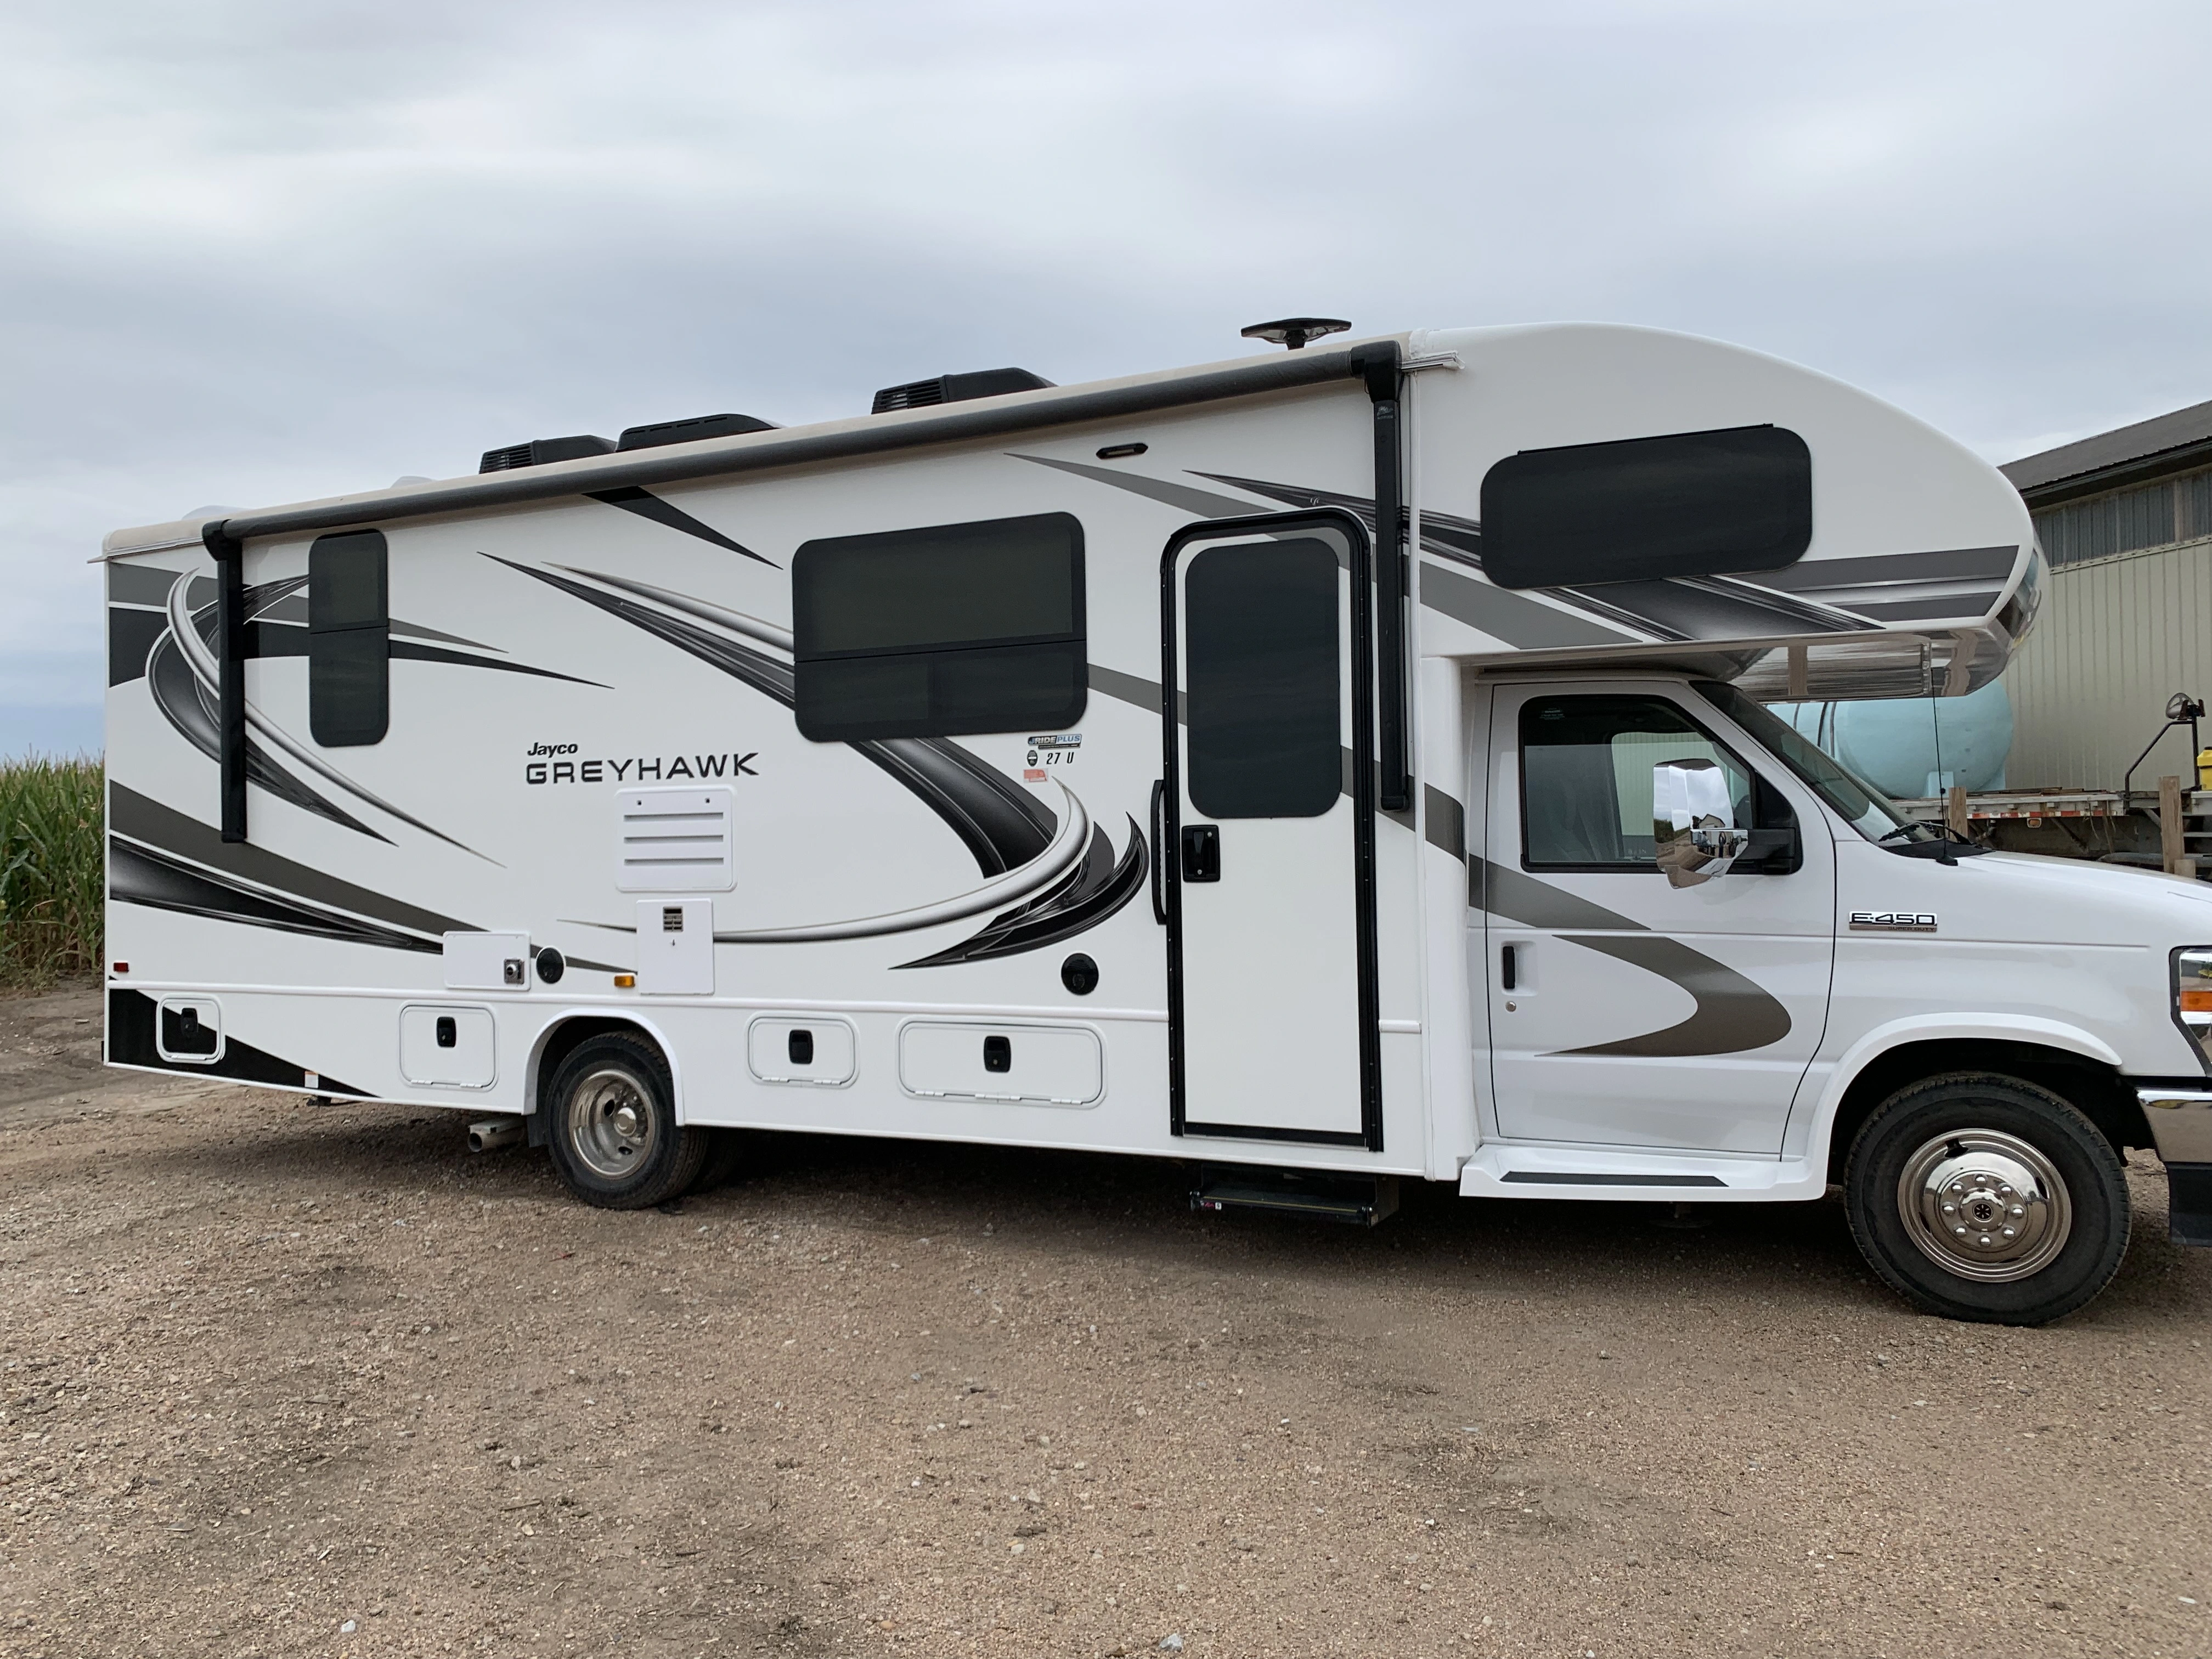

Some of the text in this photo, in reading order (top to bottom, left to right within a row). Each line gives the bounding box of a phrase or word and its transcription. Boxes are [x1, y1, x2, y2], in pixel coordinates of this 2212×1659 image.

[527, 742, 578, 758] Jayco
[1046, 752, 1061, 765] 27
[1066, 752, 1074, 764] U
[526, 753, 759, 785] GREYHAWK
[1852, 913, 1935, 925] E-450
